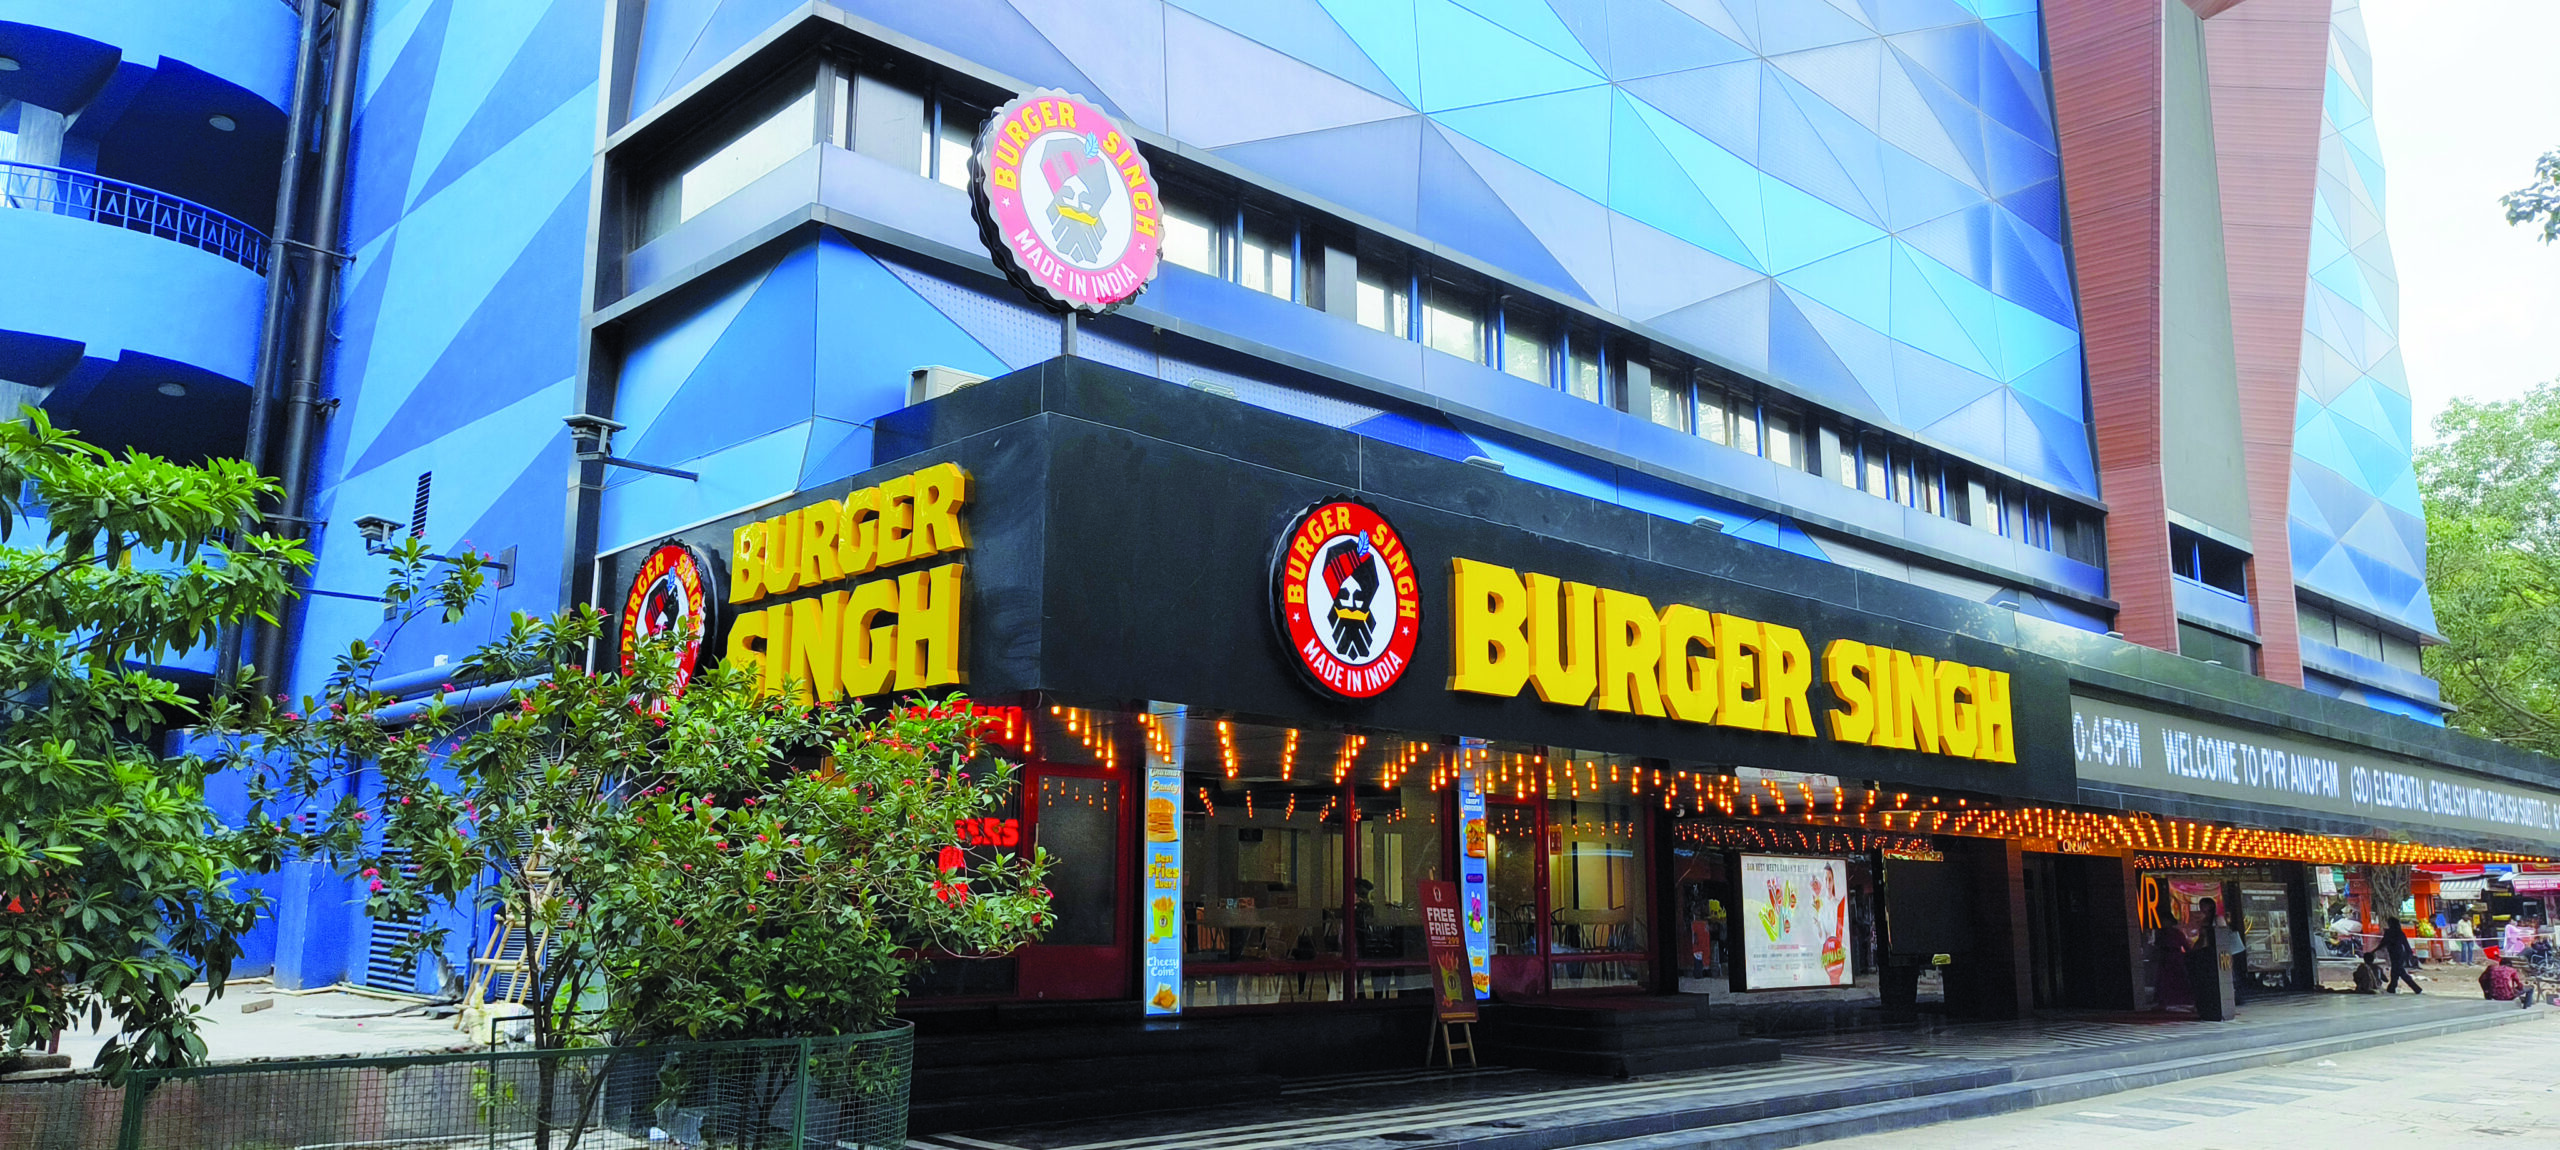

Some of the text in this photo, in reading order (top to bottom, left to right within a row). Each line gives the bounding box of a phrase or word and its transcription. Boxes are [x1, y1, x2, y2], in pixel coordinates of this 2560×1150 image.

[994, 100, 1156, 239] BURGER SINGH
[1013, 227, 1139, 300] MADE IN INDIA
[729, 461, 966, 606] BURGER
[1286, 506, 1417, 619] BURGER SINGH
[622, 552, 665, 652] BURGER
[725, 563, 965, 709] SINGH
[1302, 637, 1404, 692] MADE IN INDIA
[1453, 556, 2017, 764] BURGER SINGH
[2073, 711, 2142, 769] 0:45PM
[2162, 727, 2239, 785] WELCOME
[2240, 743, 2259, 788] TO
[2260, 747, 2288, 792] PVR
[2290, 753, 2340, 798] ANUPAM
[2351, 765, 2373, 813] (3D)
[2373, 768, 2429, 812] ELEMENTAL
[2429, 779, 2467, 820] (ENGLISH
[2466, 786, 2489, 820] WITH
[2488, 790, 2520, 825] ENGLISH
[1148, 863, 1179, 879] Fries
[1155, 853, 1173, 864] Best
[1426, 907, 1456, 922] FREE
[1429, 922, 1458, 936] FRIES
[1147, 956, 1179, 969] Cheesy
[1151, 967, 1175, 976] Coins
